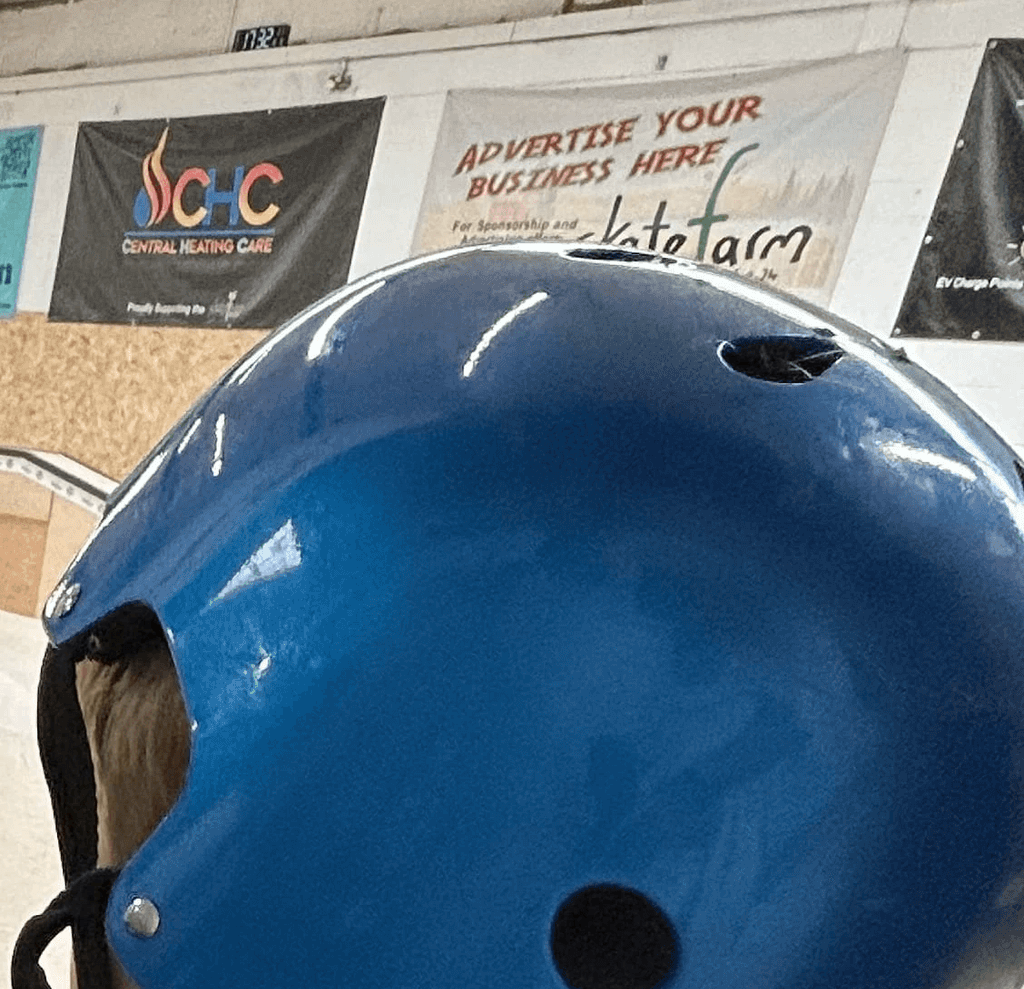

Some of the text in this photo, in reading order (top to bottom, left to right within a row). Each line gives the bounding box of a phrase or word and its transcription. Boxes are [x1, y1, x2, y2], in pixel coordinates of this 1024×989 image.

[451, 95, 764, 177] ADVERTISE YOUR
[172, 162, 284, 227] CHC
[466, 137, 730, 201] BUSINESS HERE
[122, 237, 274, 254] CENTRAL HEATING CARE
[452, 218, 579, 235] For Sponsorship and
